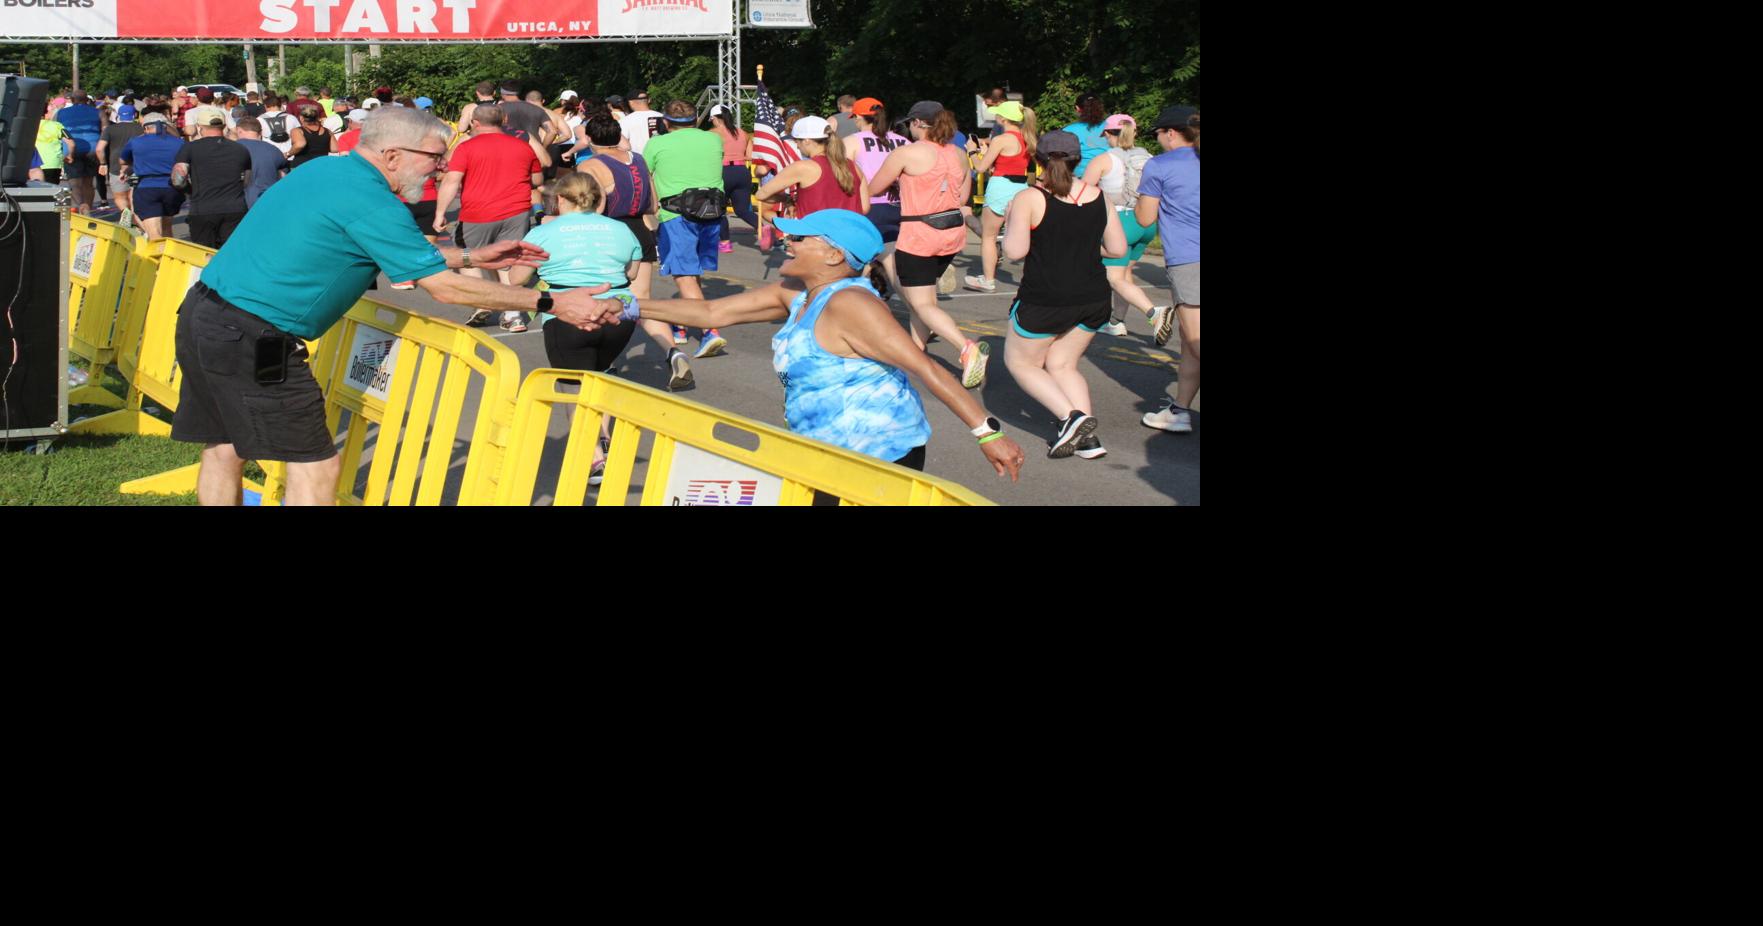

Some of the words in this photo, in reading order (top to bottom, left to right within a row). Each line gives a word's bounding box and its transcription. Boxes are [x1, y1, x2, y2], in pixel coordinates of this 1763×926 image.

[259, 0, 476, 34] START
[507, 22, 564, 33] UTICA,
[569, 21, 592, 31] NY
[350, 355, 390, 392] Boilermaker
